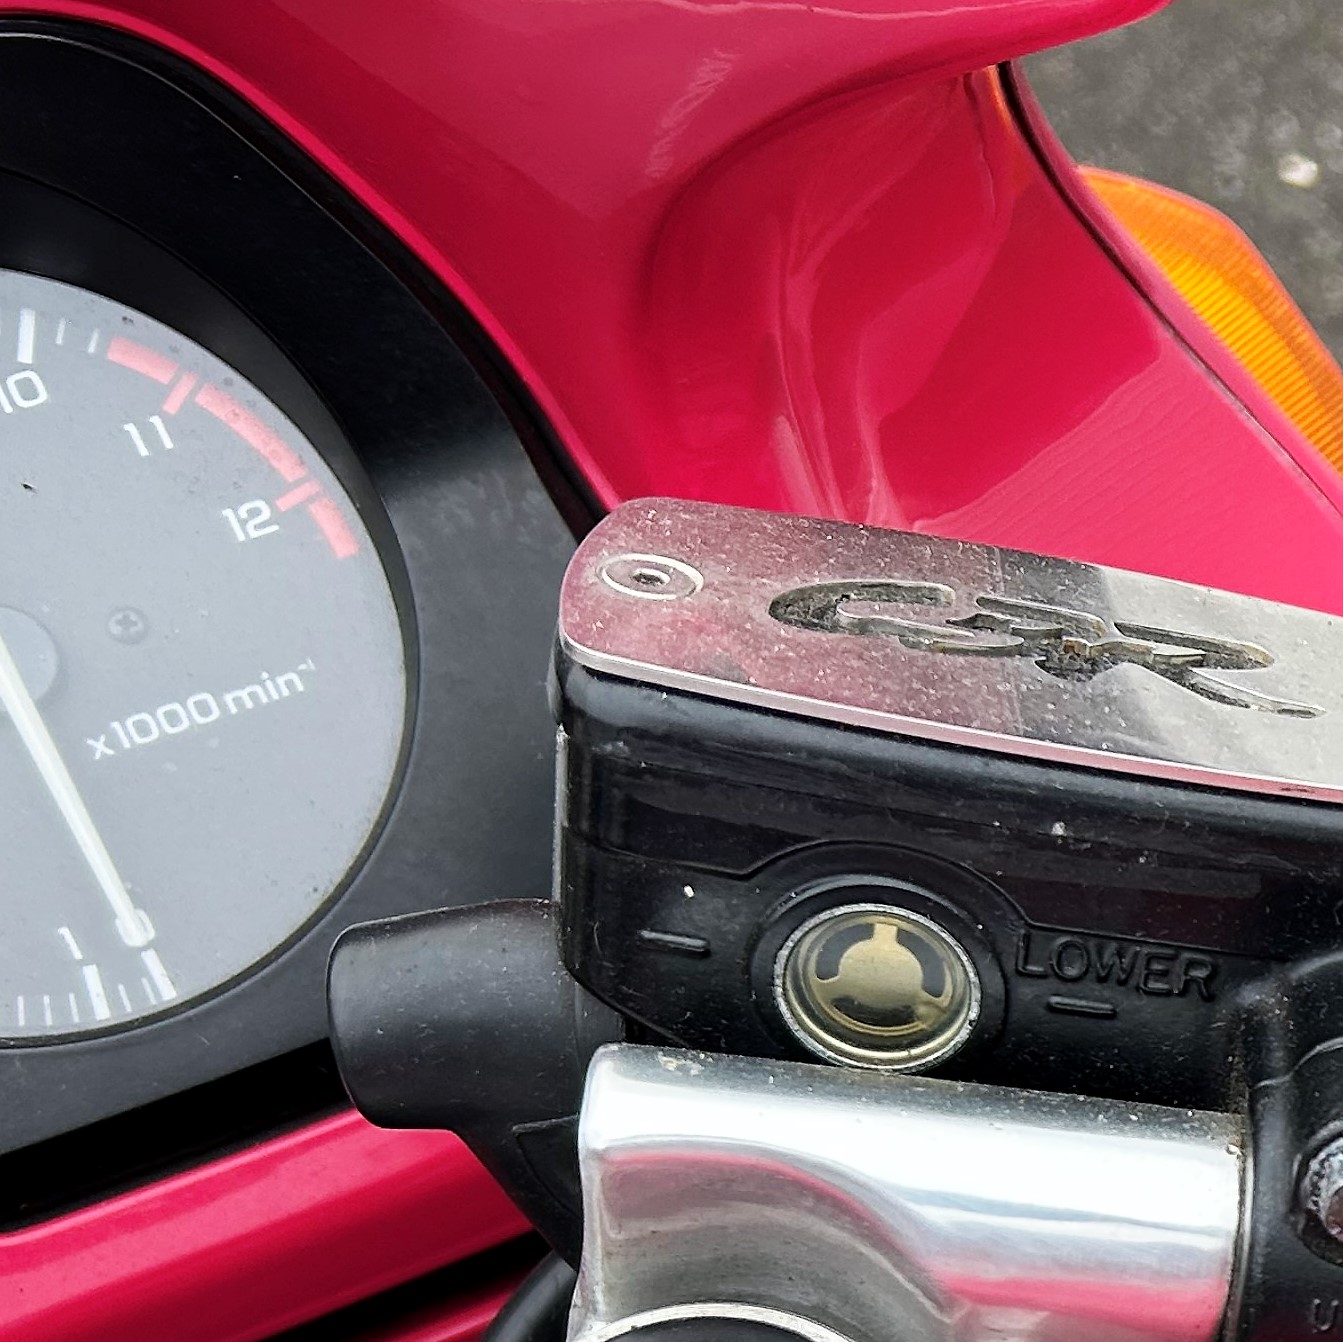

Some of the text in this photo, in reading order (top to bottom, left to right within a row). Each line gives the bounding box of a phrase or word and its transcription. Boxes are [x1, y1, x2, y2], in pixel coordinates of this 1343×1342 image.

[0, 370, 48, 414] 10
[124, 415, 173, 456] 11
[222, 500, 279, 541] 12
[58, 926, 83, 960] 1
[1016, 929, 1214, 1002] LOWER
